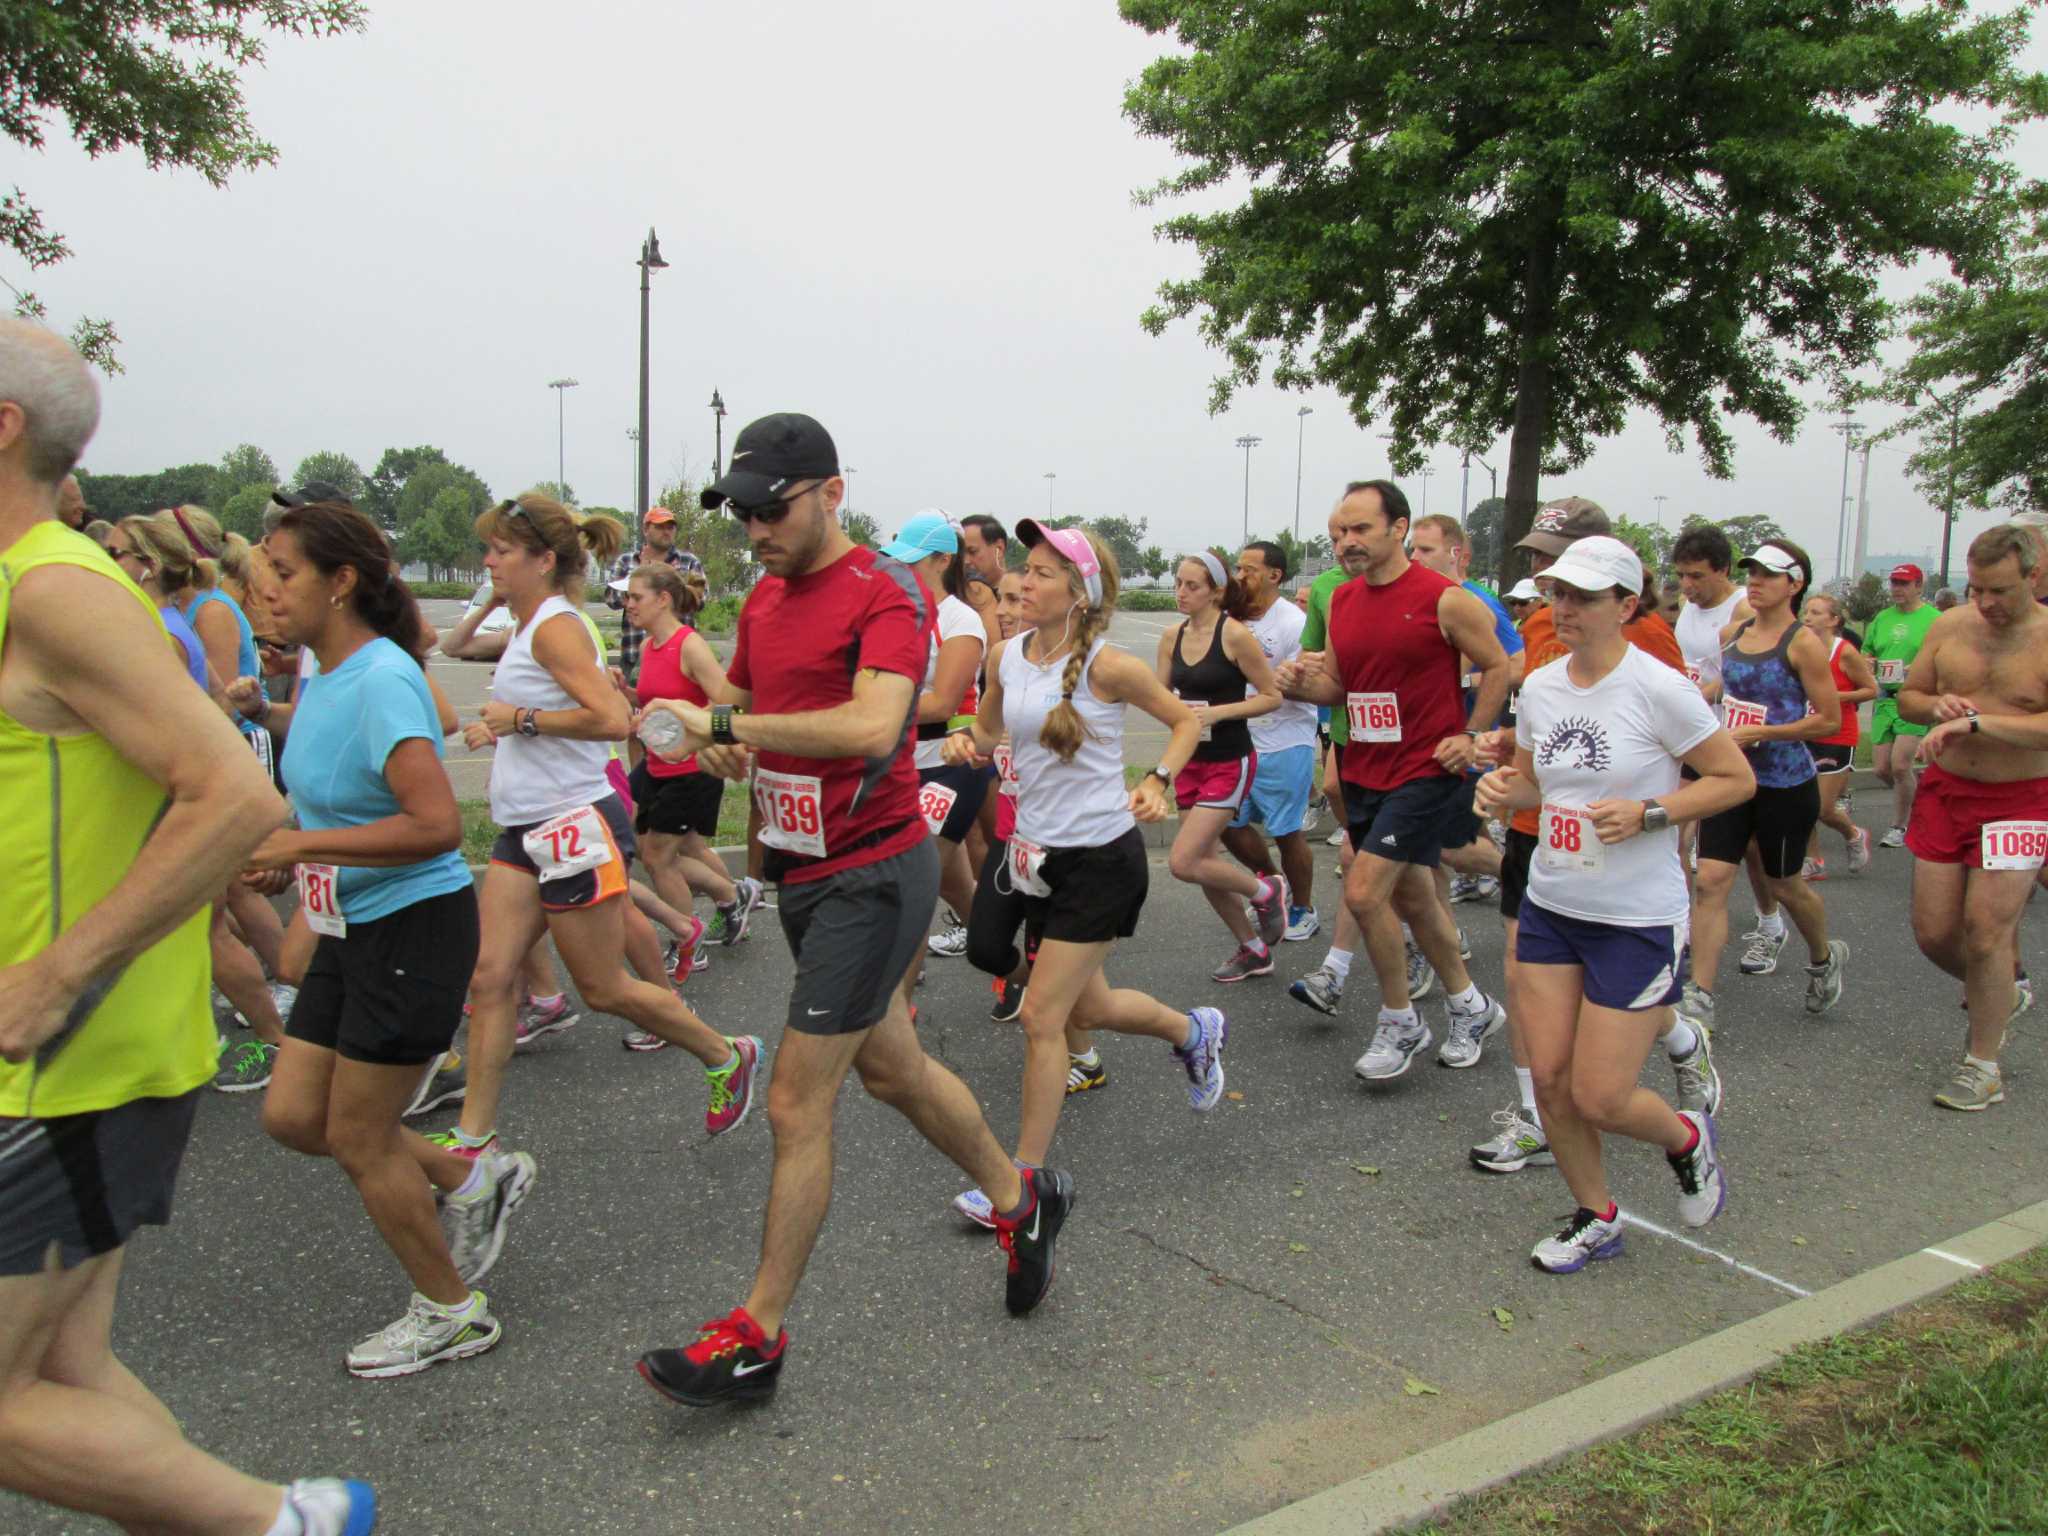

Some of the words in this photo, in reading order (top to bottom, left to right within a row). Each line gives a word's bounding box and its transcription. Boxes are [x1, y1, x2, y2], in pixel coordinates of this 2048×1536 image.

[1349, 703, 1398, 729] 1169
[756, 786, 820, 836] 1139
[542, 824, 587, 865] 72
[1550, 814, 1582, 853] 38
[1986, 831, 2047, 857] 1089
